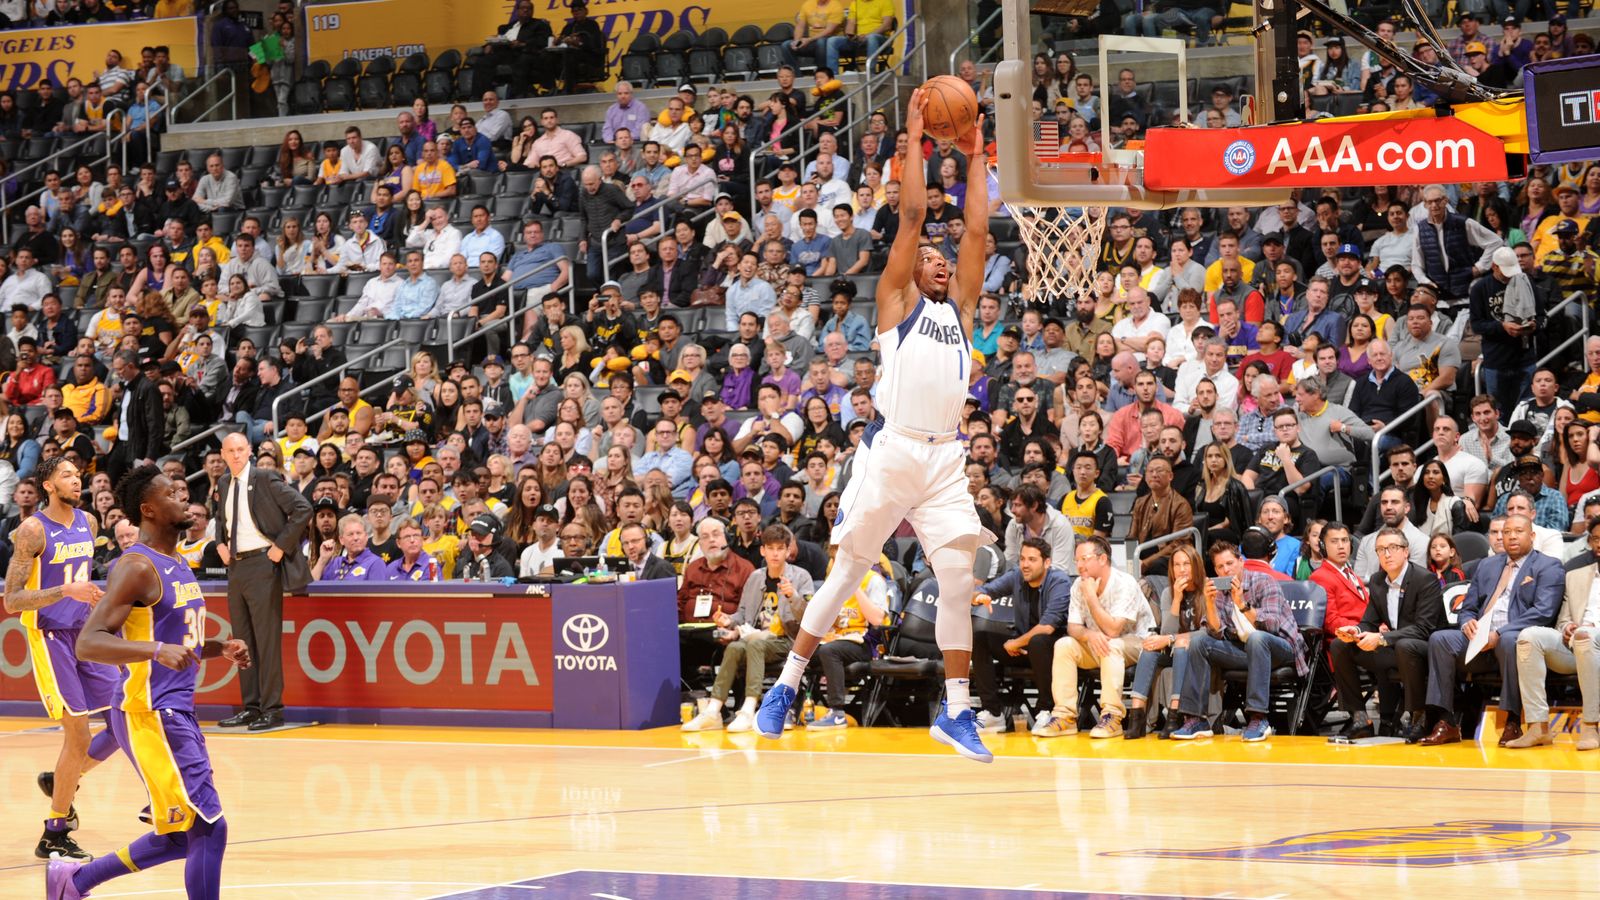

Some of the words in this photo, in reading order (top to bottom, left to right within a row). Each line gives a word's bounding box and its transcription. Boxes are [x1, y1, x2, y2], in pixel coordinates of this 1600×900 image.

[312, 14, 340, 31] 119
[0, 34, 77, 54] GELES
[1266, 134, 1475, 175] AAA.com
[957, 349, 963, 380] 1
[49, 541, 95, 564] LAKERS
[63, 561, 89, 584] 14
[525, 585, 546, 594] ANC
[183, 606, 206, 649] 30
[554, 655, 618, 671] TOYOTA
